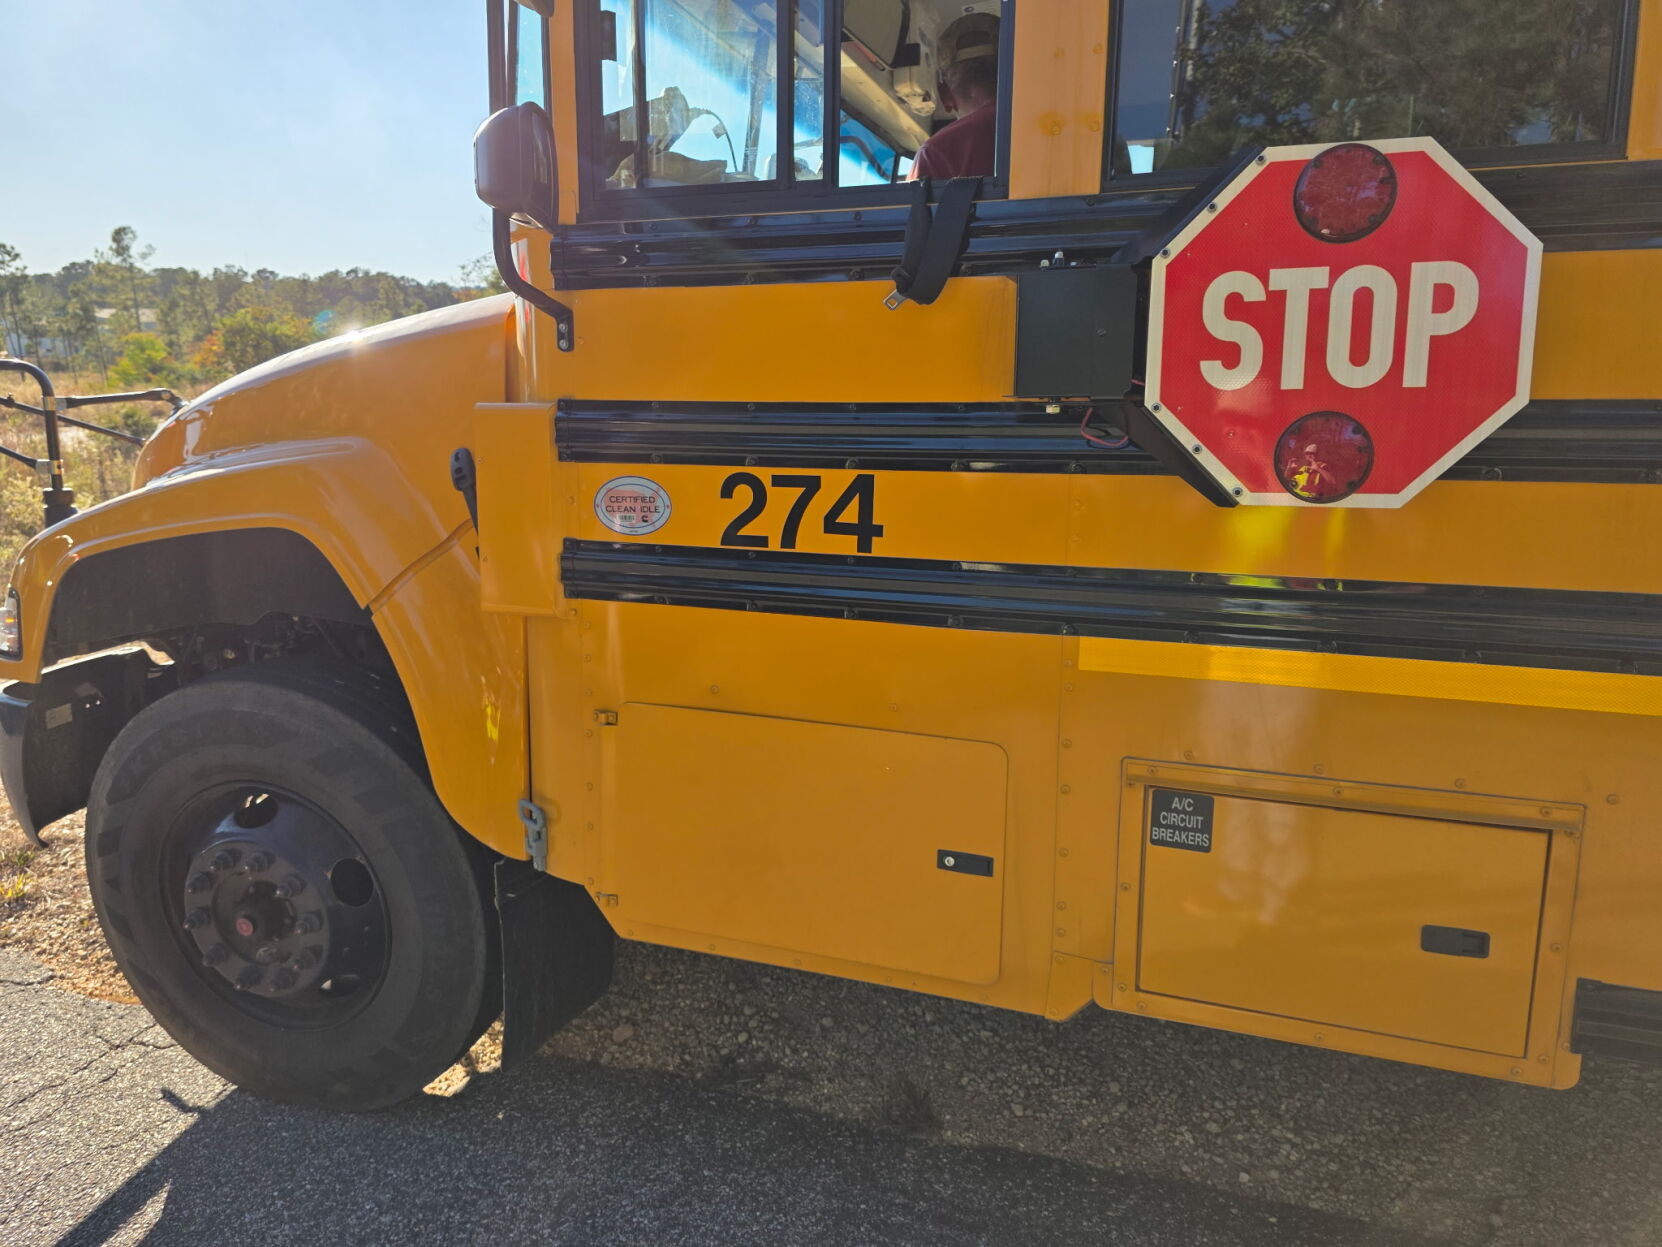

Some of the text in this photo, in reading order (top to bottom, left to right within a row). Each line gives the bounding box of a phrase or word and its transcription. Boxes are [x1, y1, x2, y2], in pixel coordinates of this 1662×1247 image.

[1199, 260, 1479, 391] STOP
[608, 495, 656, 504] CERTIFIED
[605, 505, 660, 513] CLEAN IDLE
[720, 471, 884, 553] 274
[1171, 797, 1194, 812] A/C
[1159, 811, 1204, 829] CIRCUIT
[1151, 827, 1209, 847] BREAKERS
